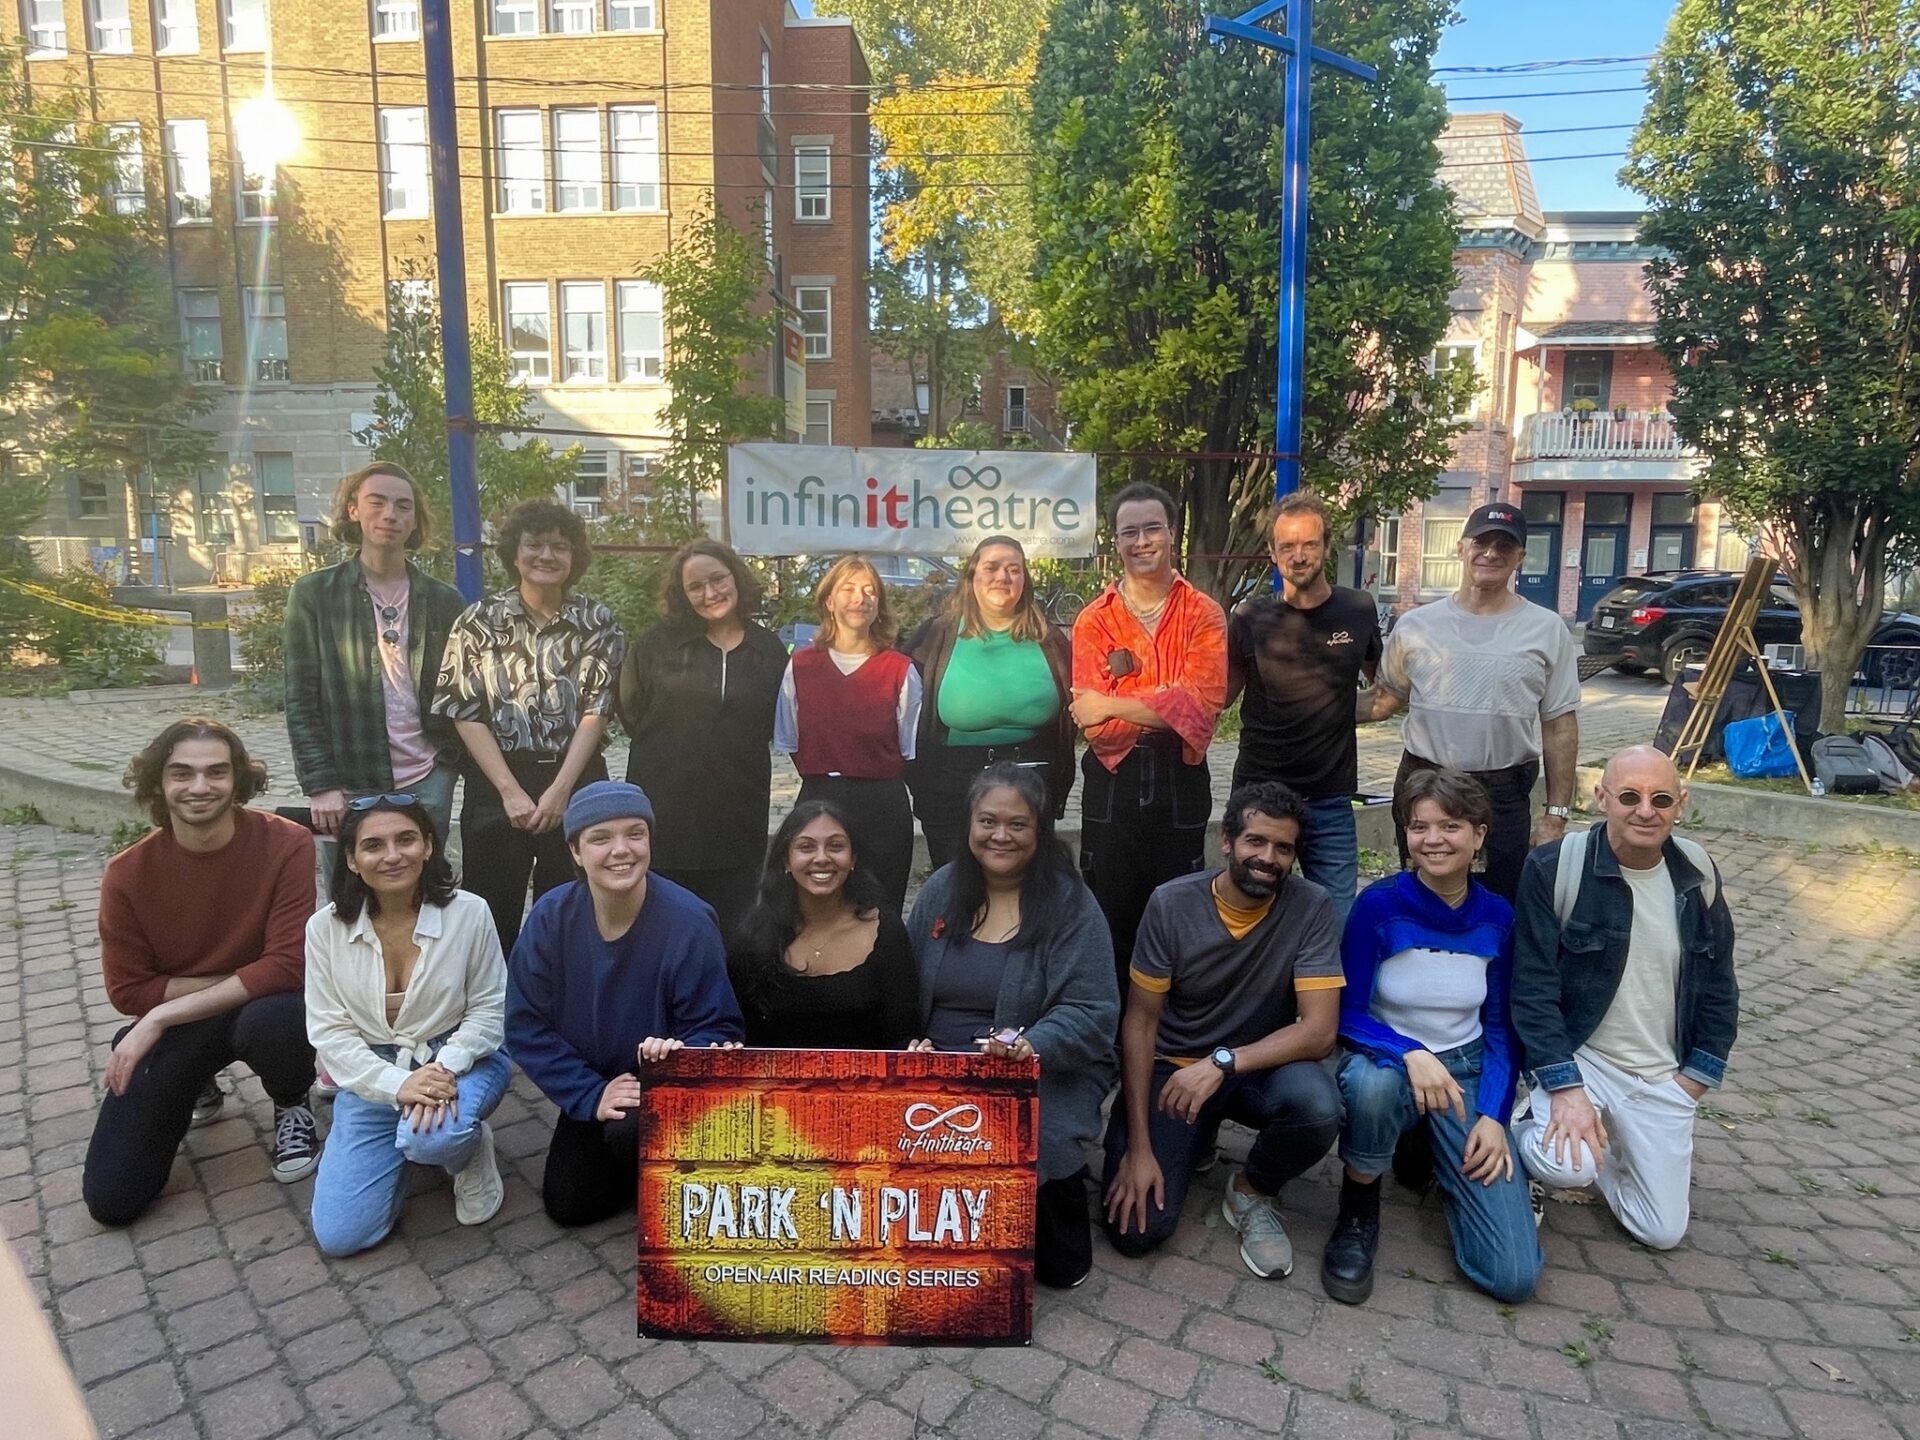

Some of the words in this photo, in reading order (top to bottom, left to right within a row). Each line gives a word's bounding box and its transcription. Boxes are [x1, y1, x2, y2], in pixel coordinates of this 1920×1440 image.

[745, 475, 1080, 531] infinitheatre
[681, 1183, 799, 1241] PARK
[880, 1186, 991, 1244] PLAY
[704, 1264, 802, 1284] OPEN-AIR
[808, 1267, 901, 1286] READING
[906, 1270, 980, 1288] SERIES
